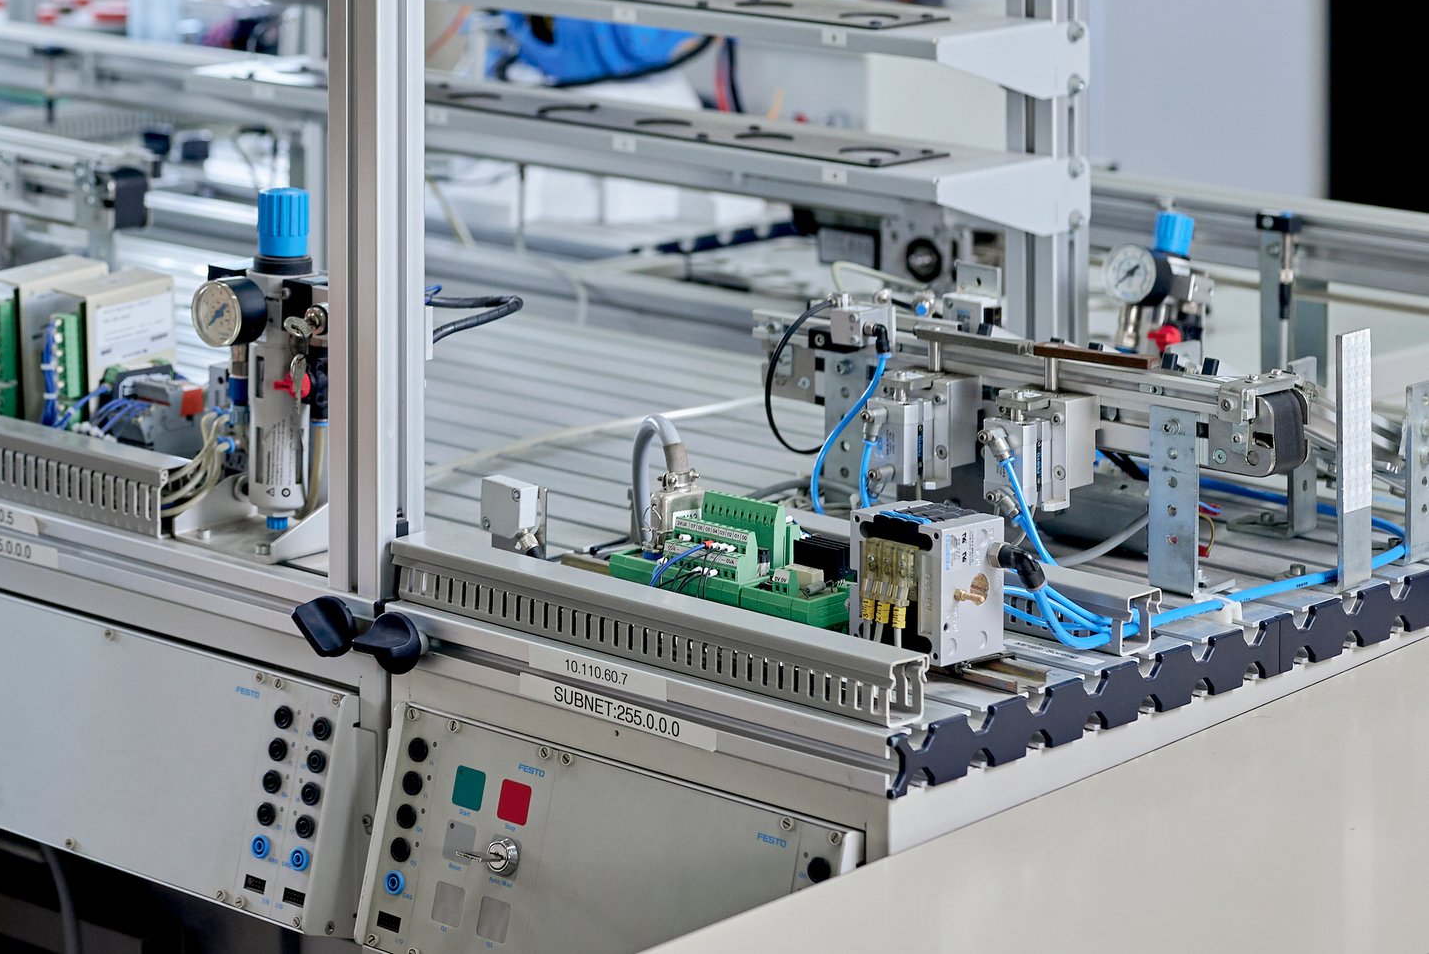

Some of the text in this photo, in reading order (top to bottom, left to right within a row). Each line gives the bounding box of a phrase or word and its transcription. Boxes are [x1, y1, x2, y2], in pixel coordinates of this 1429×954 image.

[565, 658, 628, 686] 10.110.60.7
[235, 687, 260, 699] FESTO
[553, 685, 680, 737] SUBNET:255.0.0.0
[518, 763, 545, 777] FESTO
[458, 808, 471, 817] Start
[505, 823, 516, 832] Stop
[757, 832, 787, 848] FESTO
